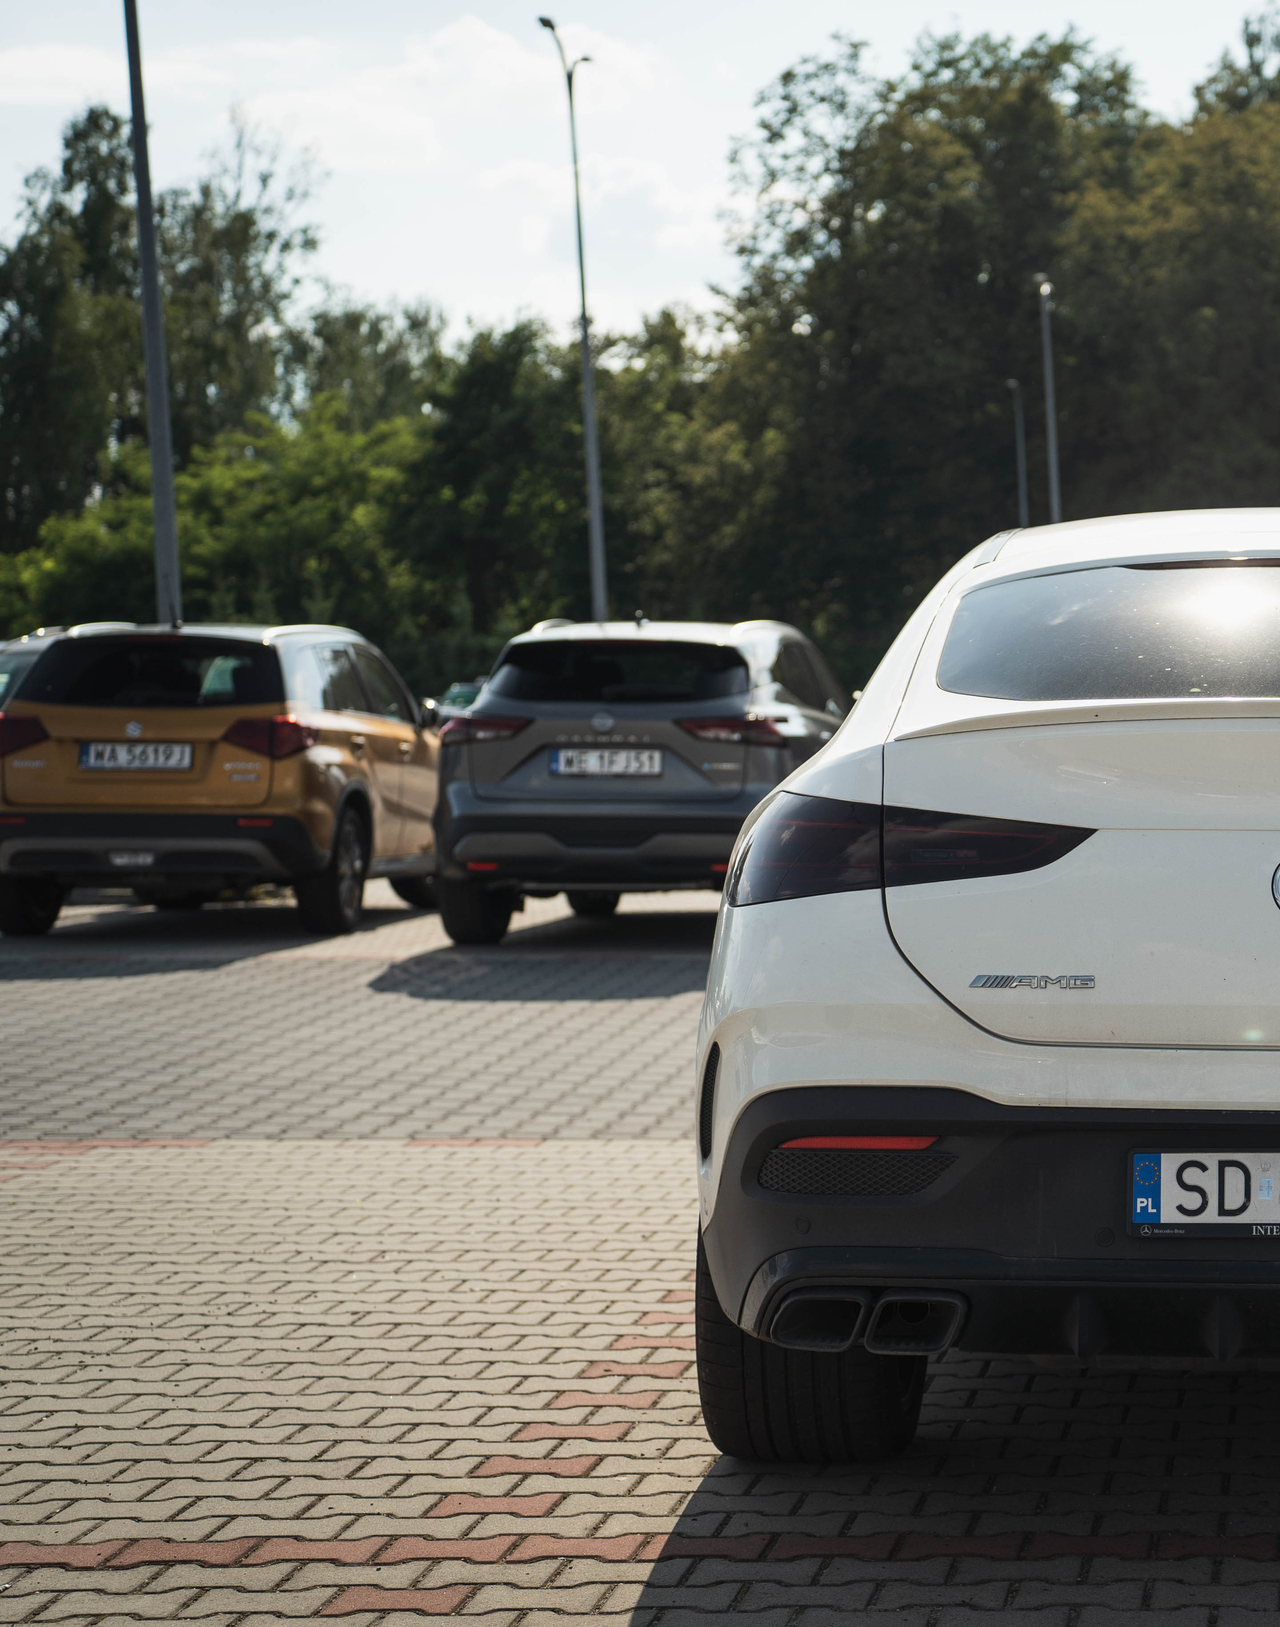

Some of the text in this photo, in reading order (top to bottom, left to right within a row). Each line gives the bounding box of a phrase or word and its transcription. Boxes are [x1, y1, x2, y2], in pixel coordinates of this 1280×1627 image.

[1008, 974, 1096, 989] AMG
[1175, 1160, 1252, 1218] SD
[1136, 1198, 1158, 1213] PL
